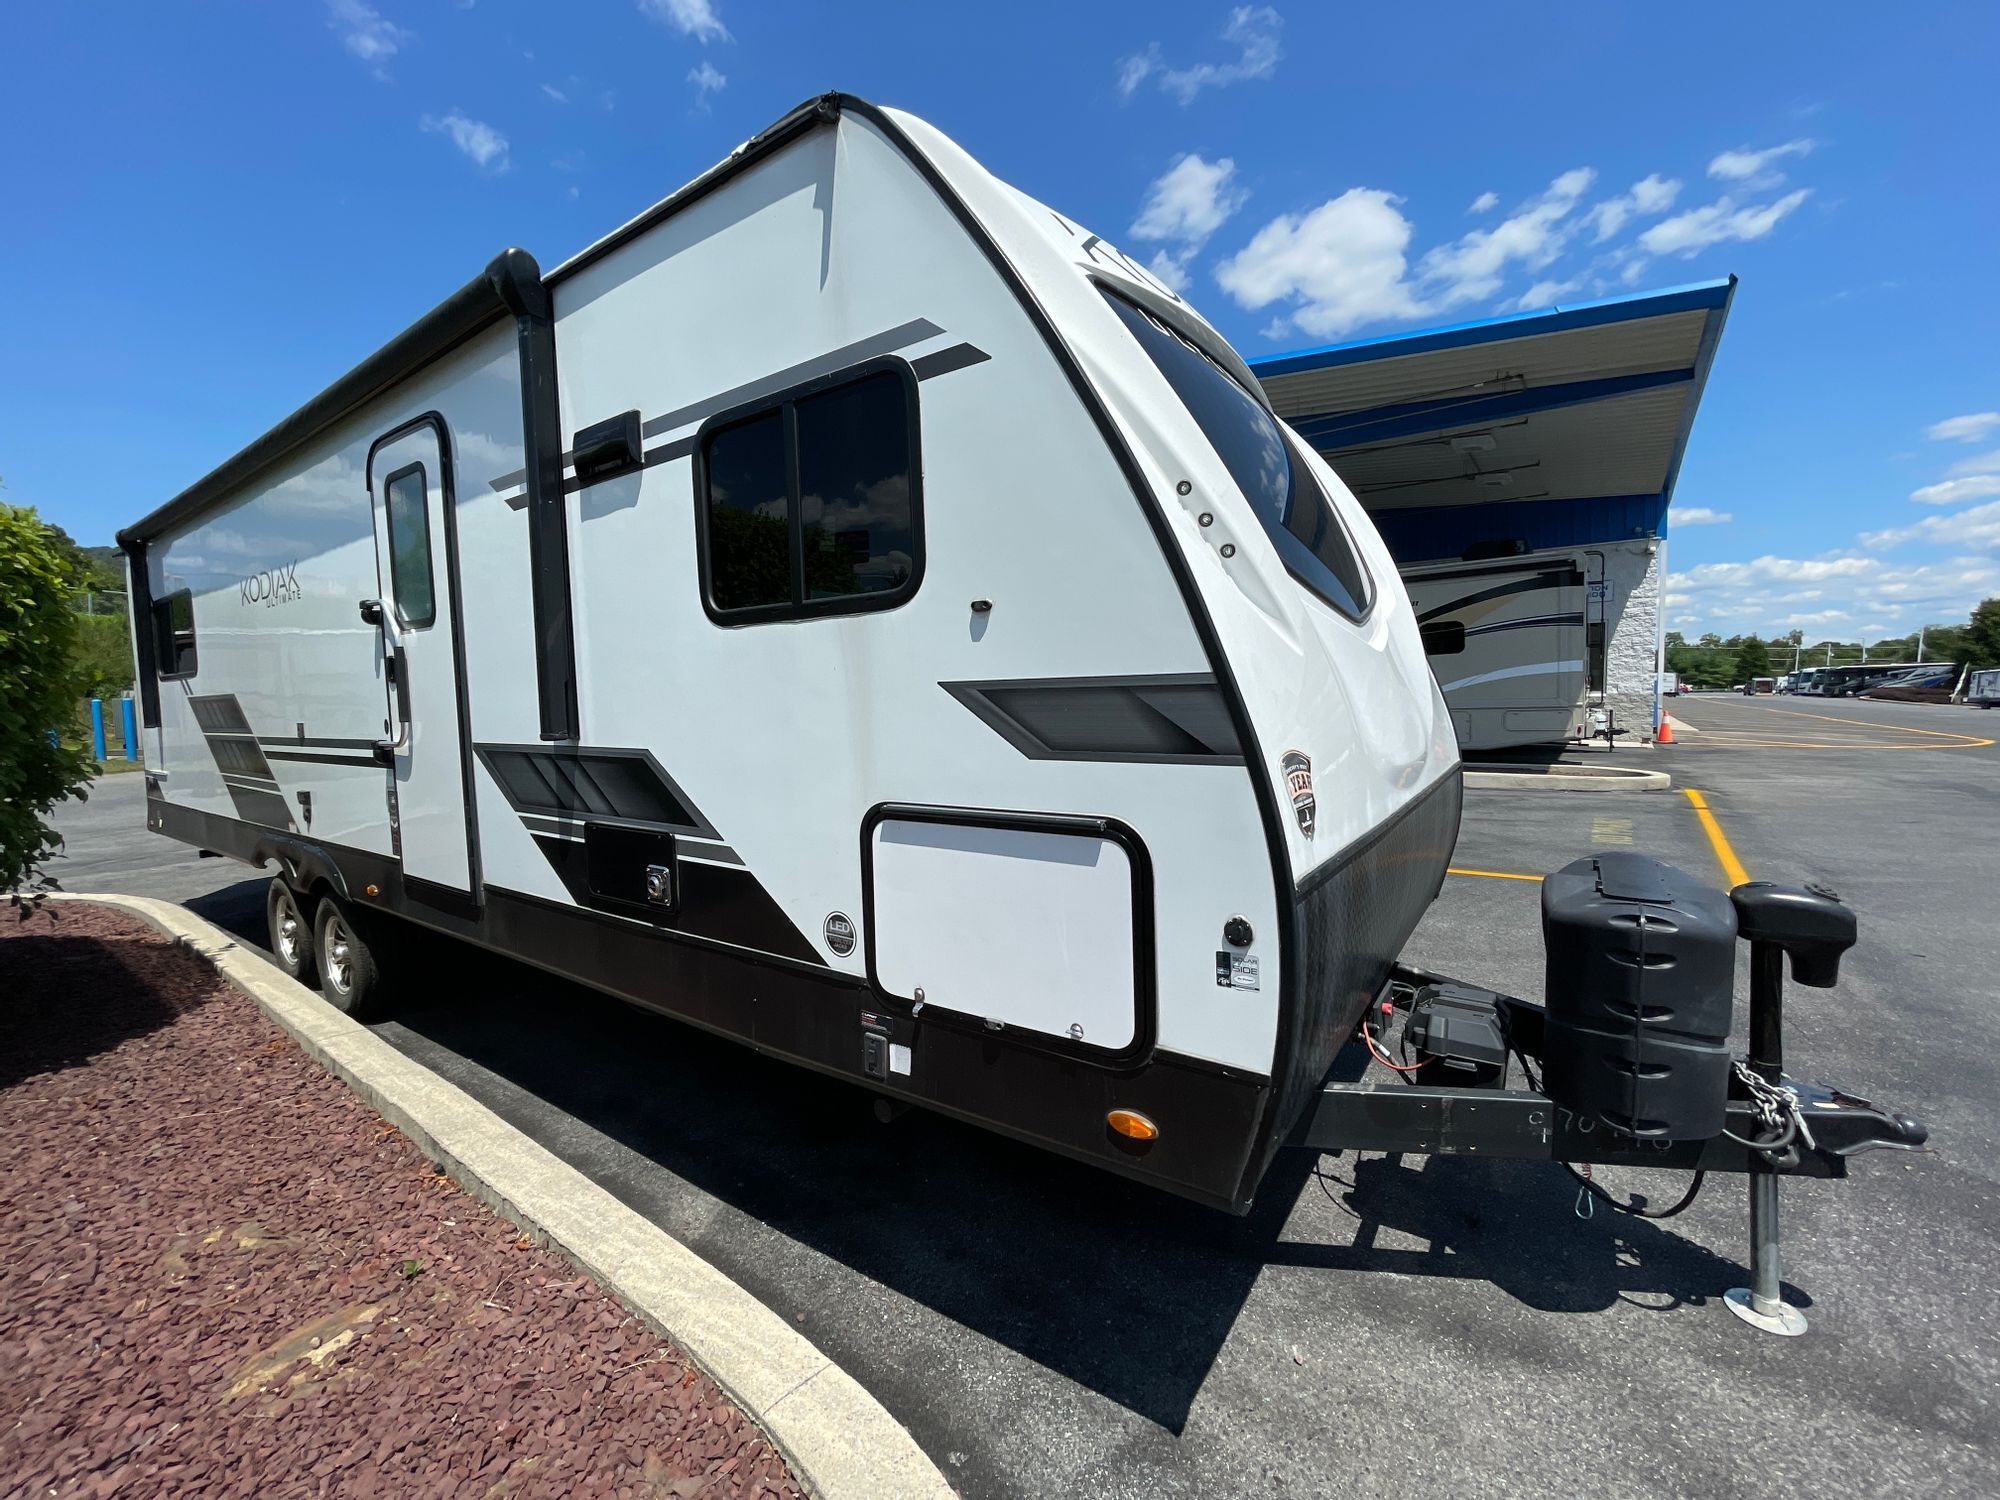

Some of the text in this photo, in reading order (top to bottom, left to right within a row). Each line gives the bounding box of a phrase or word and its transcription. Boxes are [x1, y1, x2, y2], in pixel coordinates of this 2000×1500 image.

[239, 559, 300, 607] KODIAK
[266, 589, 301, 608] ULTIMATE
[829, 919, 850, 933] LED
[1232, 965, 1258, 976] SIDE
